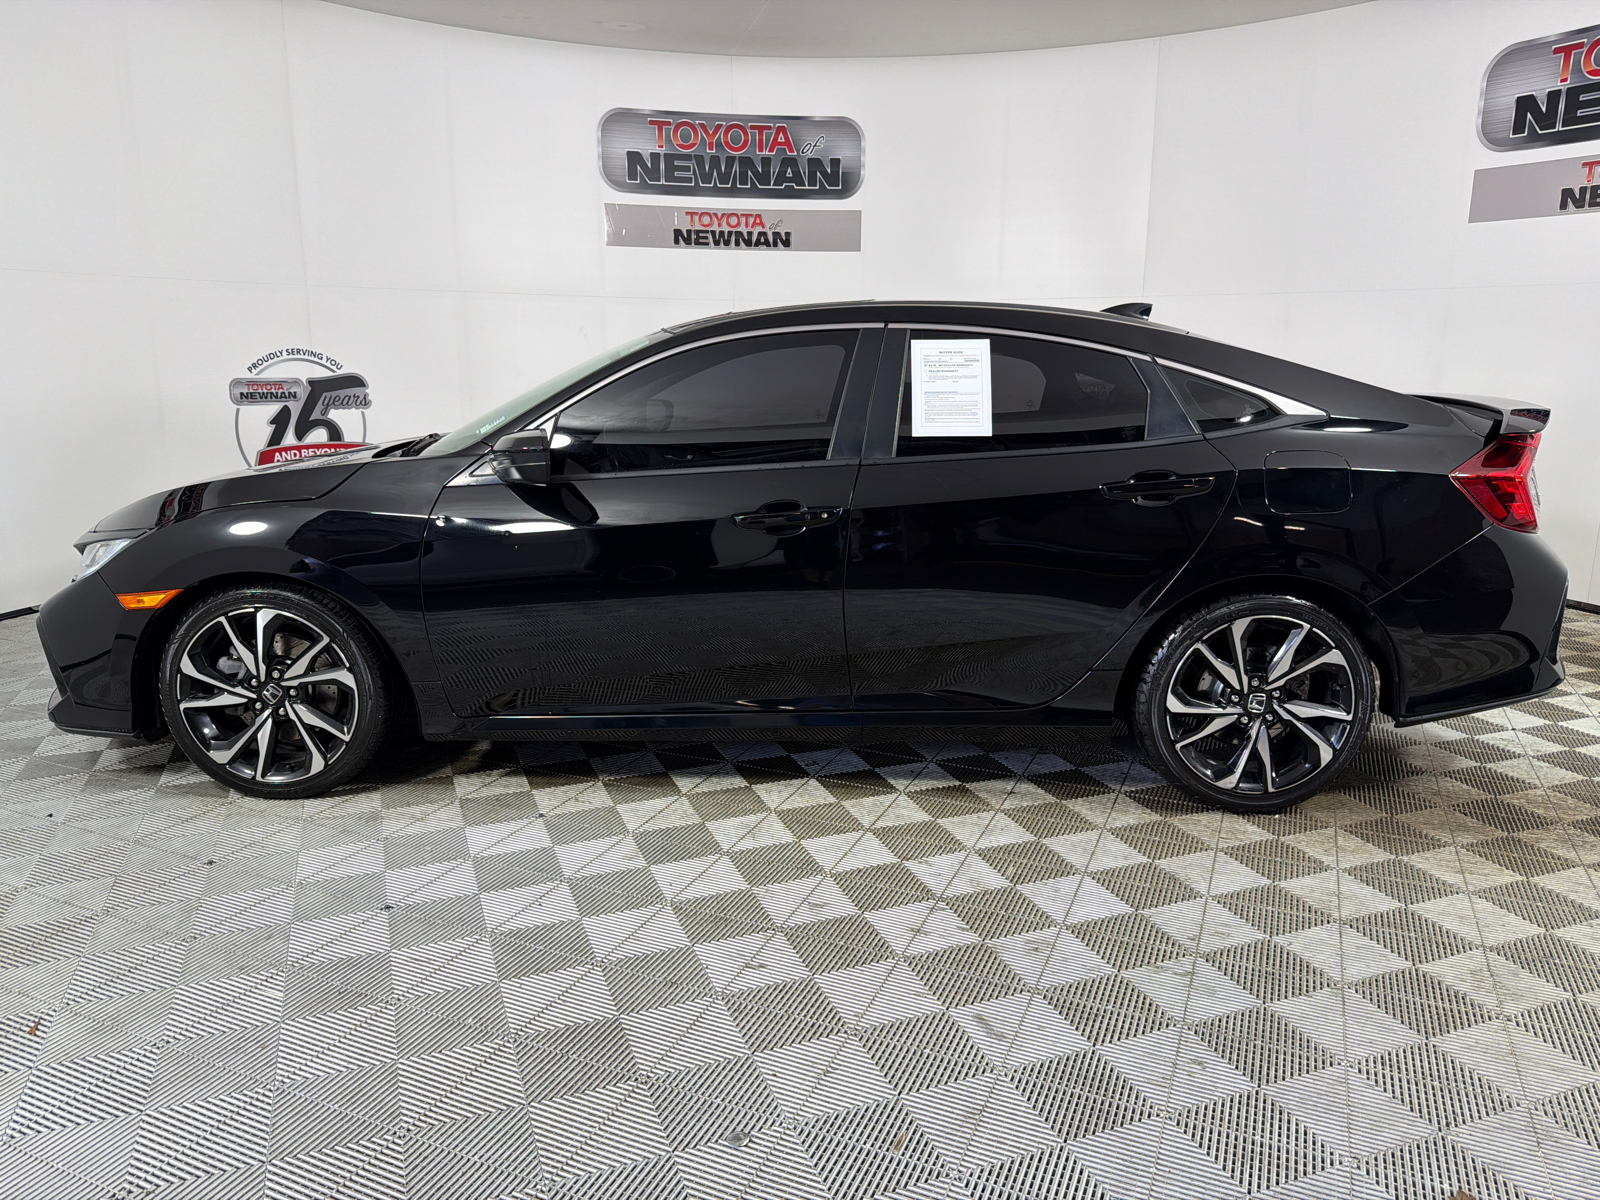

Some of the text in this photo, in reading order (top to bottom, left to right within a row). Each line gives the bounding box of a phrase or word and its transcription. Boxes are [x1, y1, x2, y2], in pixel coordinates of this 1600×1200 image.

[648, 118, 825, 155] TOYOTA of
[626, 150, 842, 189] NEWNAN
[685, 211, 783, 231] TOYOTA of
[673, 228, 792, 248] NEWNAN
[247, 348, 343, 374] PROUDLY SERVING YOU
[239, 391, 298, 400] NEWNAN
[245, 383, 285, 392] TOYOTA
[267, 375, 367, 448] 15
[320, 393, 370, 416] years
[273, 450, 300, 463] AND
[301, 448, 345, 459] BEYO
